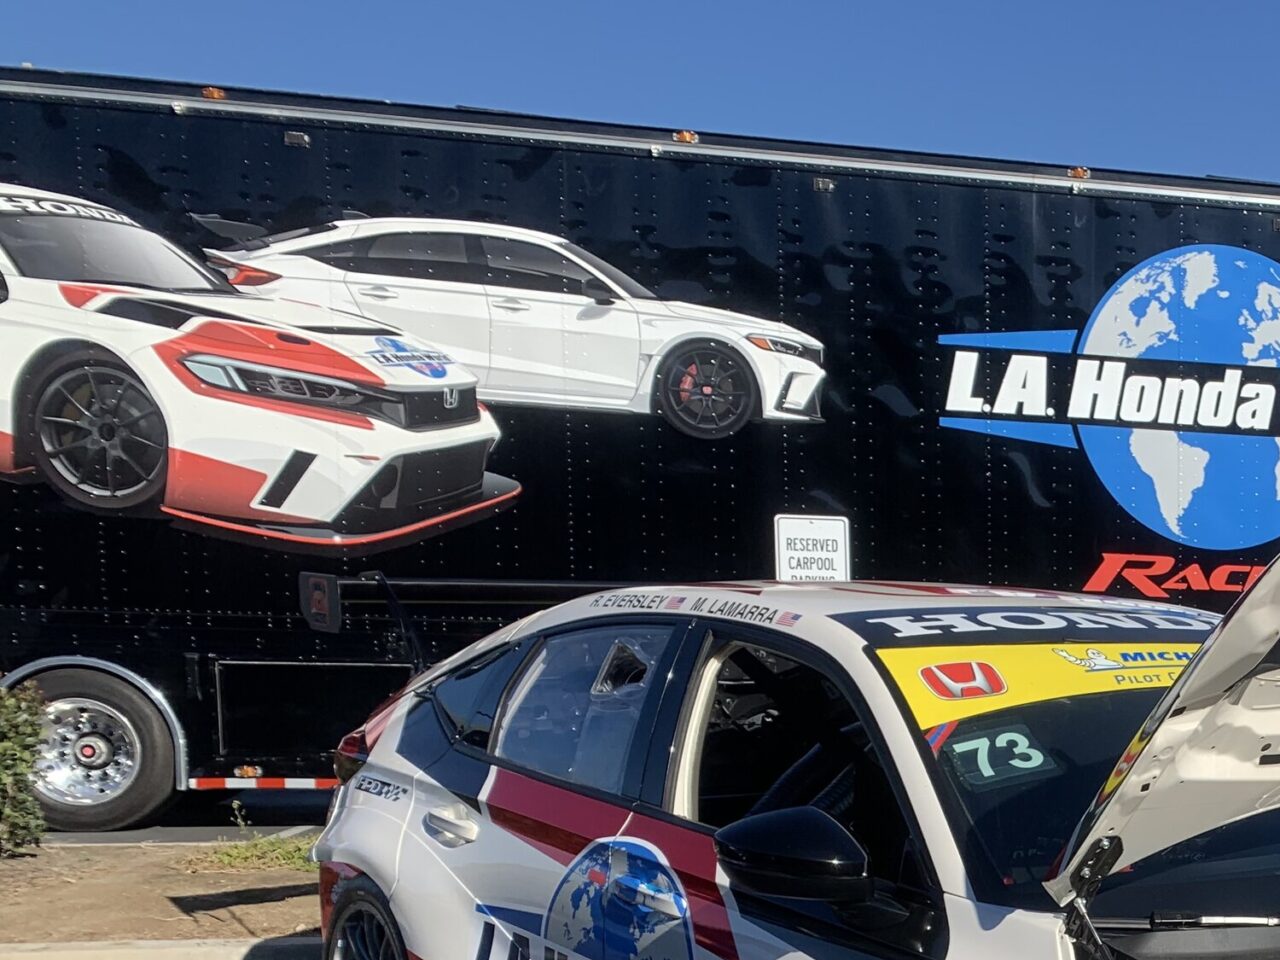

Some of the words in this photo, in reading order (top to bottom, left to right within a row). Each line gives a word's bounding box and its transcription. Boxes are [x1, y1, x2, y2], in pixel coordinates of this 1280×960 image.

[945, 350, 1056, 417] L.A.
[1067, 358, 1277, 431] Honda
[786, 537, 838, 553] RESERVED
[788, 556, 837, 571] CARPOOL
[1082, 552, 1268, 598] RACI
[590, 595, 601, 608] R.
[603, 594, 669, 610] EVERSLEY
[689, 597, 705, 611] M.
[708, 600, 779, 624] LAMARRA
[866, 612, 1220, 638] HOND
[1120, 651, 1209, 662] MICH
[1114, 674, 1170, 685] PILOT
[952, 732, 1044, 777] 73
